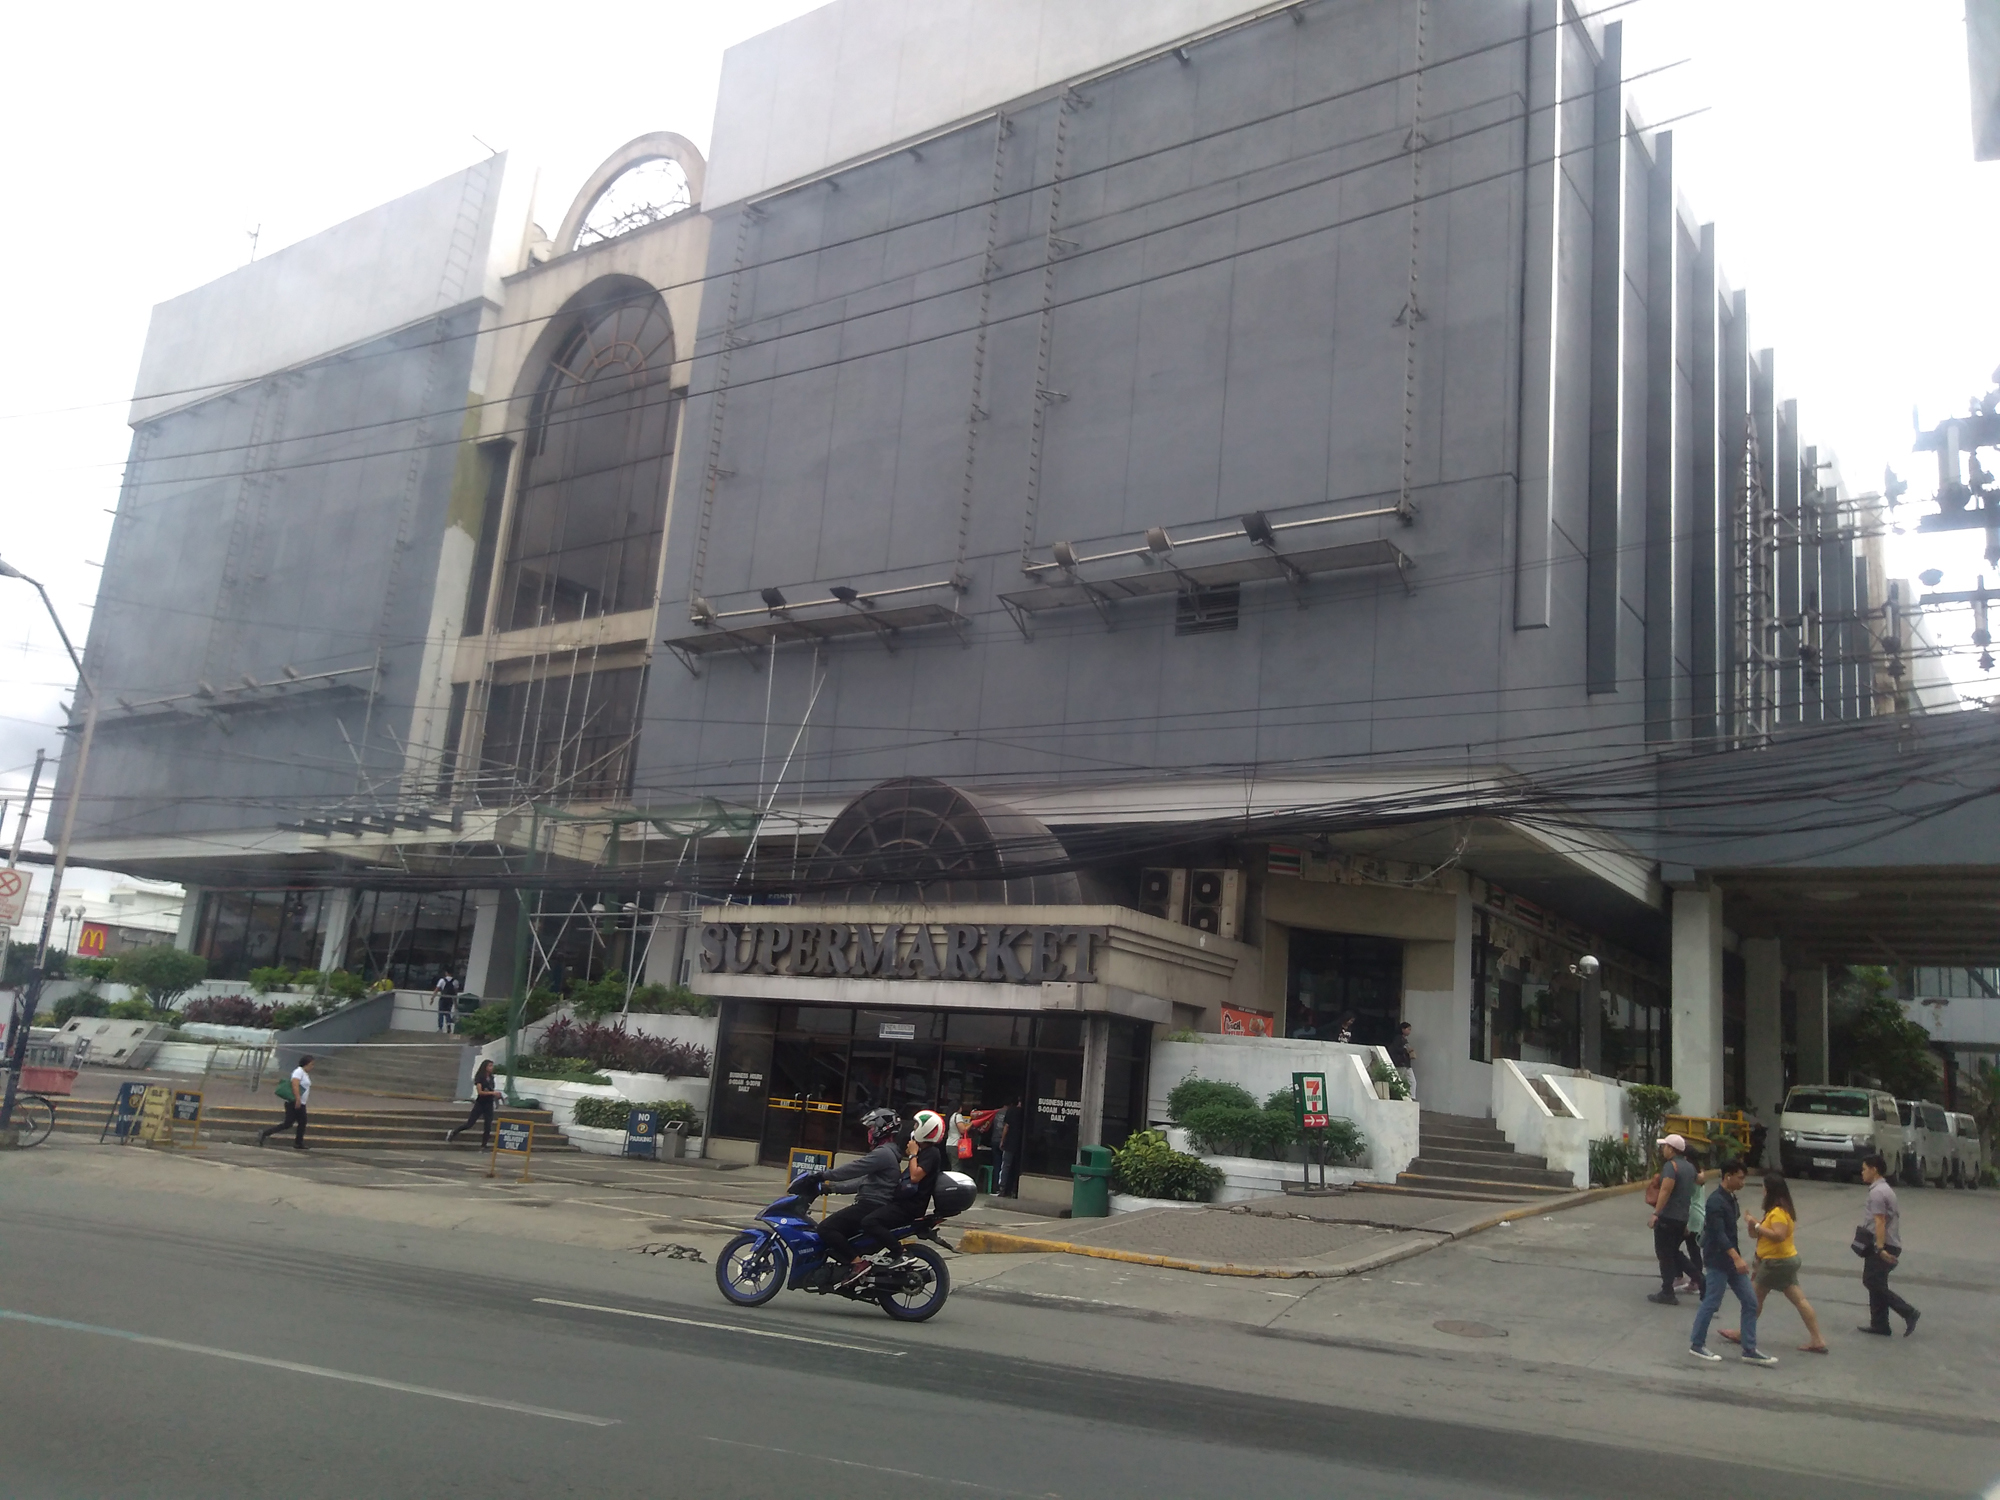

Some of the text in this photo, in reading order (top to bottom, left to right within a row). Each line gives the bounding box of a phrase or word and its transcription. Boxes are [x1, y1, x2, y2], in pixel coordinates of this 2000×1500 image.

[700, 922, 1107, 983] SUPERMARKET
[130, 1085, 145, 1095] NO
[1038, 1098, 1081, 1109] BUSINESS HOURS
[638, 1113, 650, 1121] NO
[1050, 1114, 1066, 1122] DAILY
[804, 1155, 815, 1163] FOR
